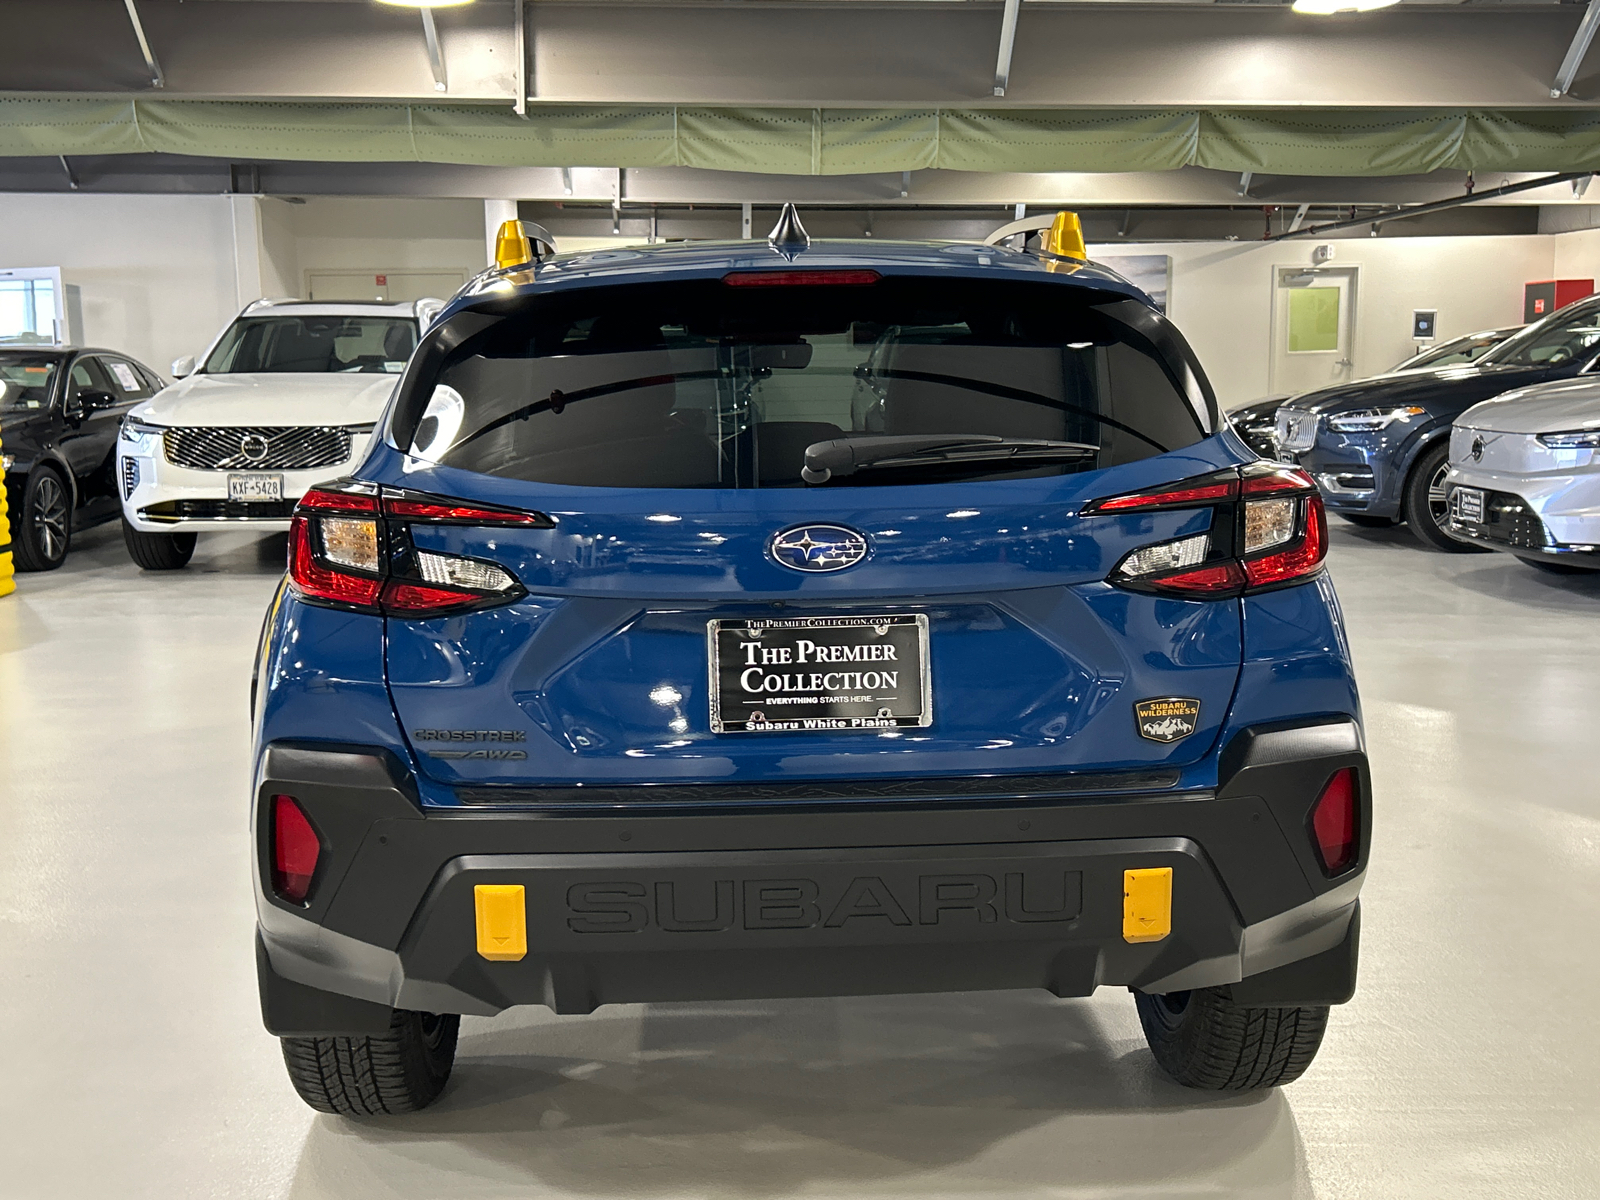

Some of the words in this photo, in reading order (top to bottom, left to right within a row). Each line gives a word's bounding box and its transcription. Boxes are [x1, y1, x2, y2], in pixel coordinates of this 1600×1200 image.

[740, 641, 792, 666] THE
[796, 639, 898, 663] PREMIER
[740, 667, 899, 693] COLLECTION
[766, 697, 819, 705] EVERYTHING
[819, 696, 849, 704] STARTS
[1150, 702, 1187, 711] SUBARU
[1140, 707, 1197, 717] WILDERNESS
[746, 721, 799, 731] Subaru
[803, 719, 847, 729] White
[851, 718, 897, 728] Plains
[413, 729, 526, 742] CROSSTREK
[566, 870, 1083, 934] SUBARU
